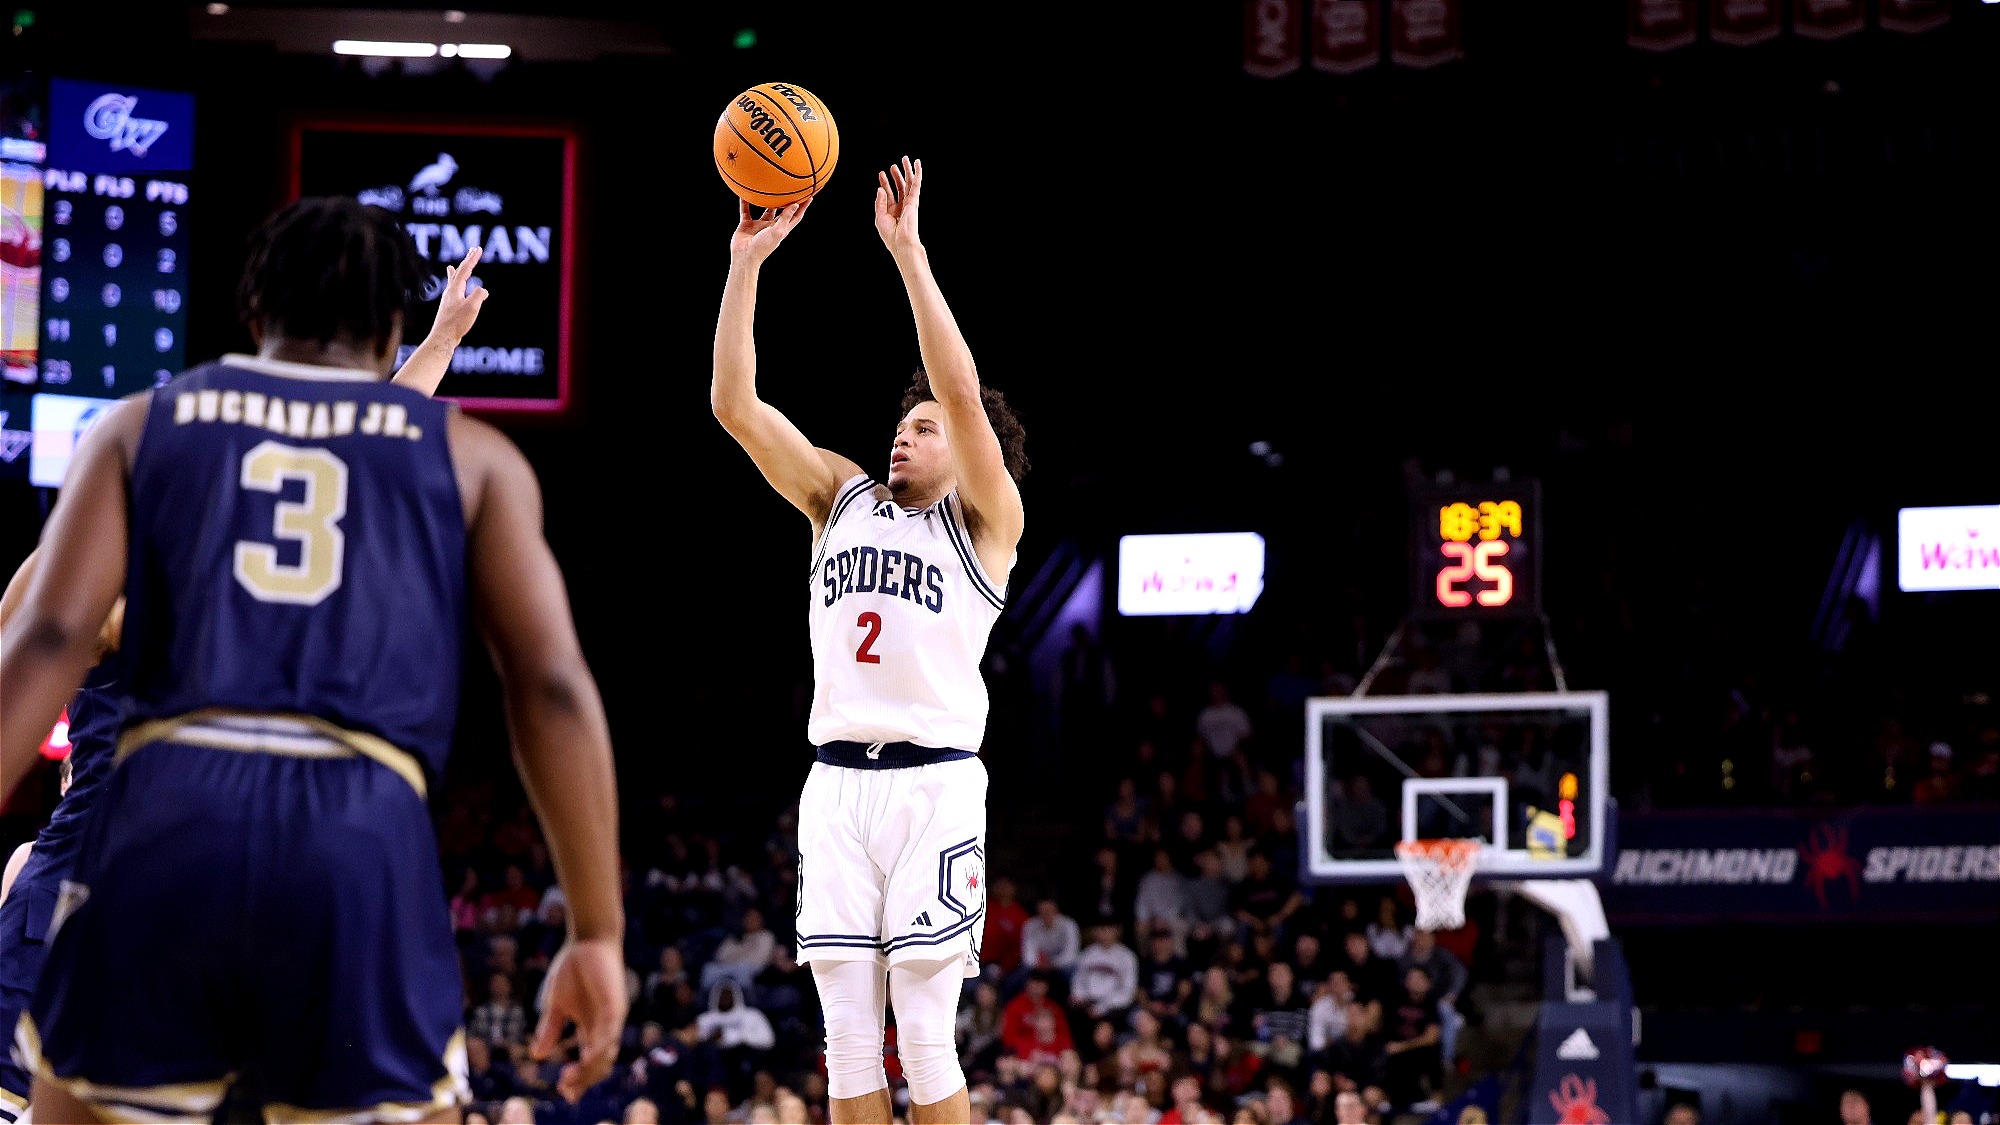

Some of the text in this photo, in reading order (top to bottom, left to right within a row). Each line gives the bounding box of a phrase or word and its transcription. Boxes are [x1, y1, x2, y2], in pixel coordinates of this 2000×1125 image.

[771, 83, 818, 122] NCAA
[736, 94, 793, 159] Wilson
[54, 200, 72, 225] 2
[104, 205, 124, 231] 0
[52, 238, 176, 273] 3 0 2
[405, 223, 551, 263] TMAN
[101, 282, 121, 308] 0
[46, 318, 70, 343] 11
[104, 323, 117, 348] 1
[102, 364, 115, 389] 1
[451, 346, 544, 375] HOME
[173, 390, 423, 441] BUCHANAN JR.
[233, 440, 349, 606] 3
[1439, 500, 1522, 542] 18:39
[823, 546, 944, 614] SPIDERS
[1436, 540, 1513, 608] 25
[855, 611, 882, 665] 2
[1613, 846, 2000, 885] RICHMOND SPIDERS
